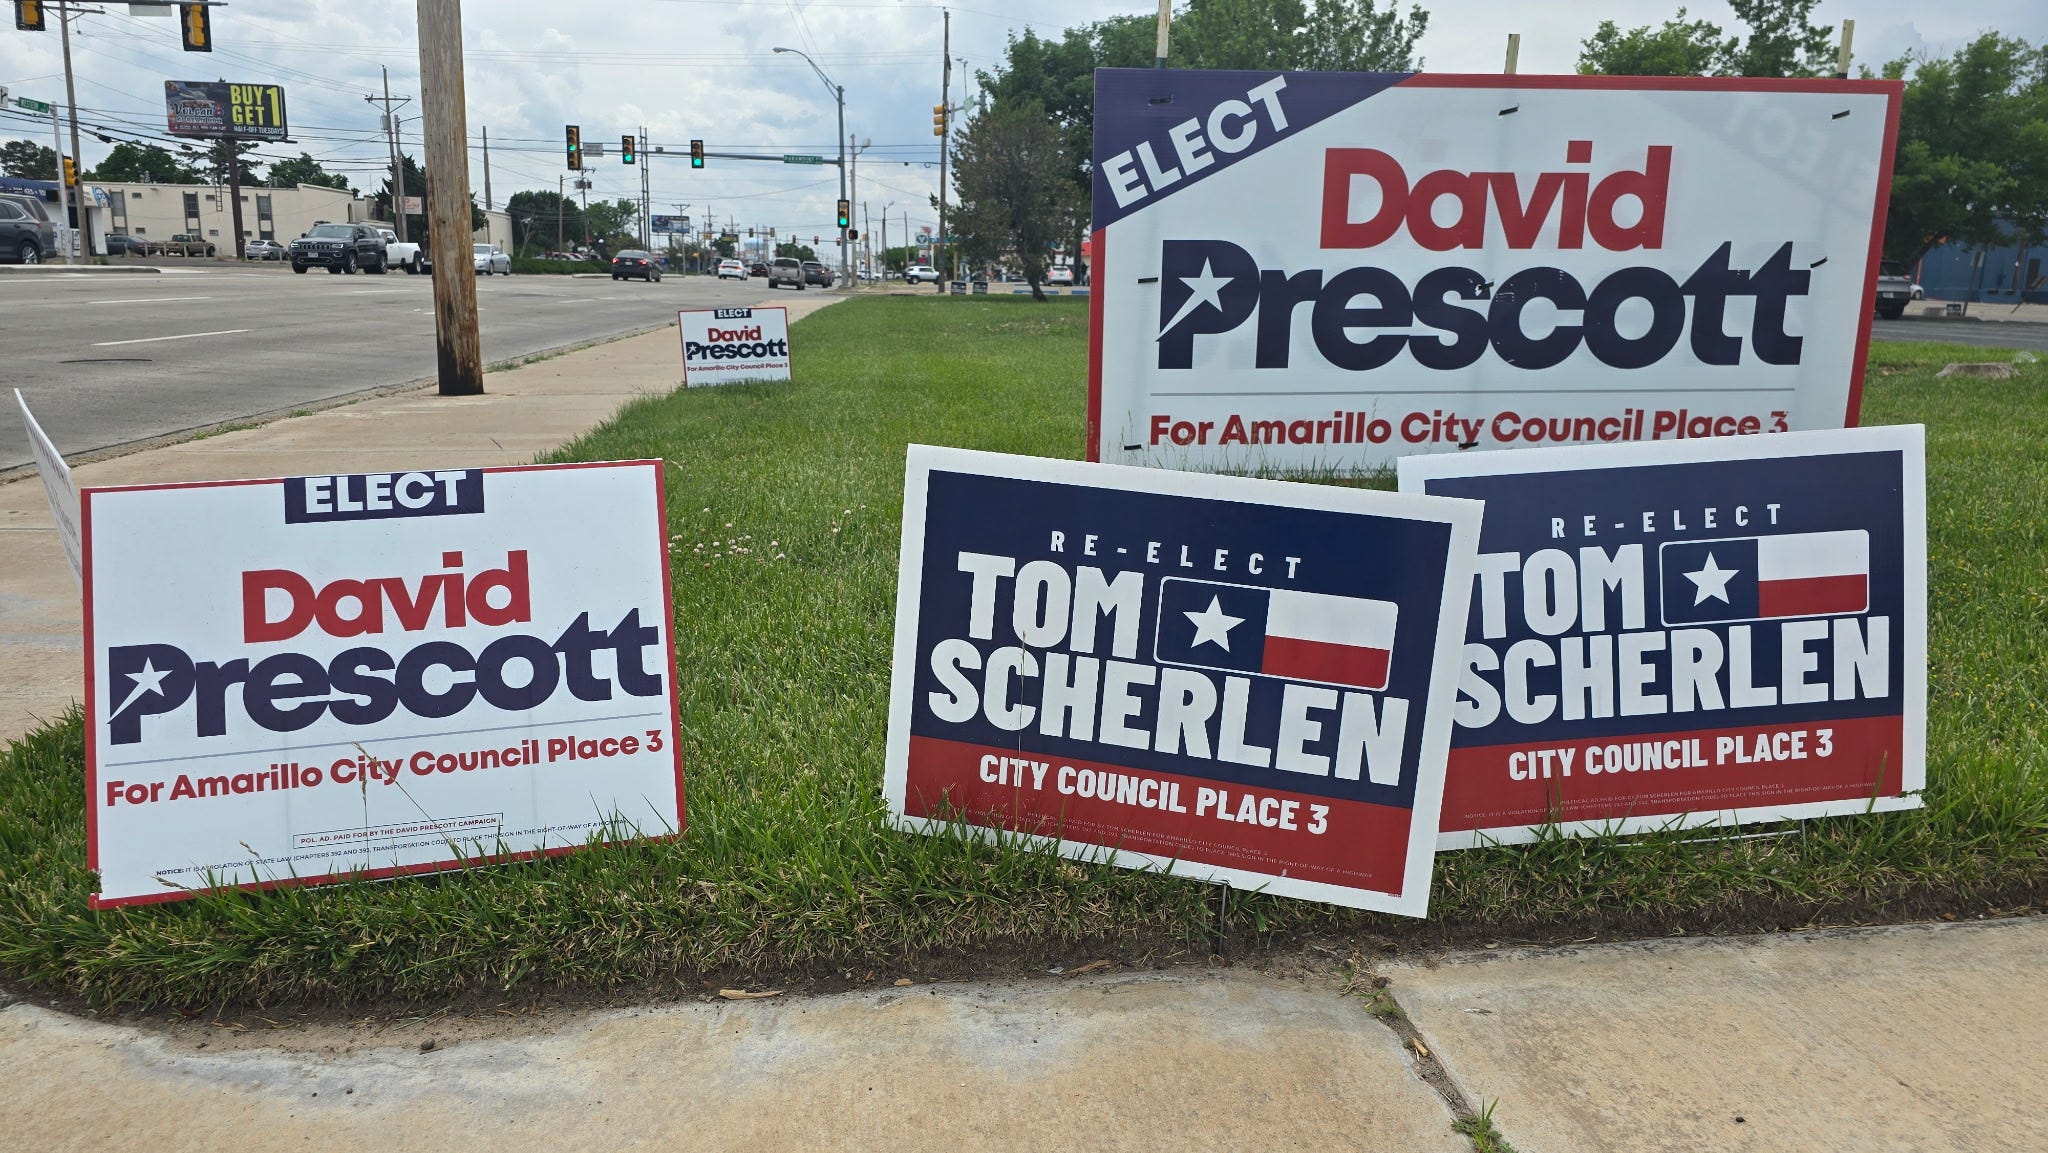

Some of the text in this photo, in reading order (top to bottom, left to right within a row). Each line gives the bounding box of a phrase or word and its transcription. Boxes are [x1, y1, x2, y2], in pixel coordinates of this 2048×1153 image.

[230, 85, 281, 127] BUY 1
[231, 105, 264, 125] GET
[1102, 75, 1288, 208] ELECT
[1322, 142, 1671, 251] David
[718, 309, 748, 318] ELECT
[1157, 239, 1811, 371] Prescott
[685, 338, 788, 360] Prescott
[708, 325, 762, 342] David
[740, 362, 765, 370] Council
[765, 361, 783, 369] Place
[1150, 408, 1788, 447] For Amarillo City Council Place 3
[305, 471, 467, 513] ELECT
[1552, 504, 1780, 538] RE-ELECT
[1051, 531, 1301, 578] RE-ELECT
[243, 550, 531, 643] David
[958, 551, 1145, 660] TOM
[1477, 544, 1646, 640] TOM
[107, 608, 663, 745] Prescott
[1453, 616, 1889, 729] SCHERLEN
[929, 639, 1410, 787] SCHERLEN
[106, 731, 663, 806] For Amarillo City Council Place 3
[1509, 729, 1833, 780] CITY COUNCIL PLACE 3
[980, 754, 1330, 835] CITY COUNCIL PLACE 3
[156, 867, 184, 877] NOTICE:
[185, 866, 191, 874] IT
[342, 848, 357, 856] AND
[372, 840, 429, 853] TRANSPORTATION
[515, 829, 522, 837] IN
[523, 828, 535, 836] THE
[300, 816, 496, 844] POL. AD. PAID FOR BY THE DAVID PRESCOTT CAMPAIGN
